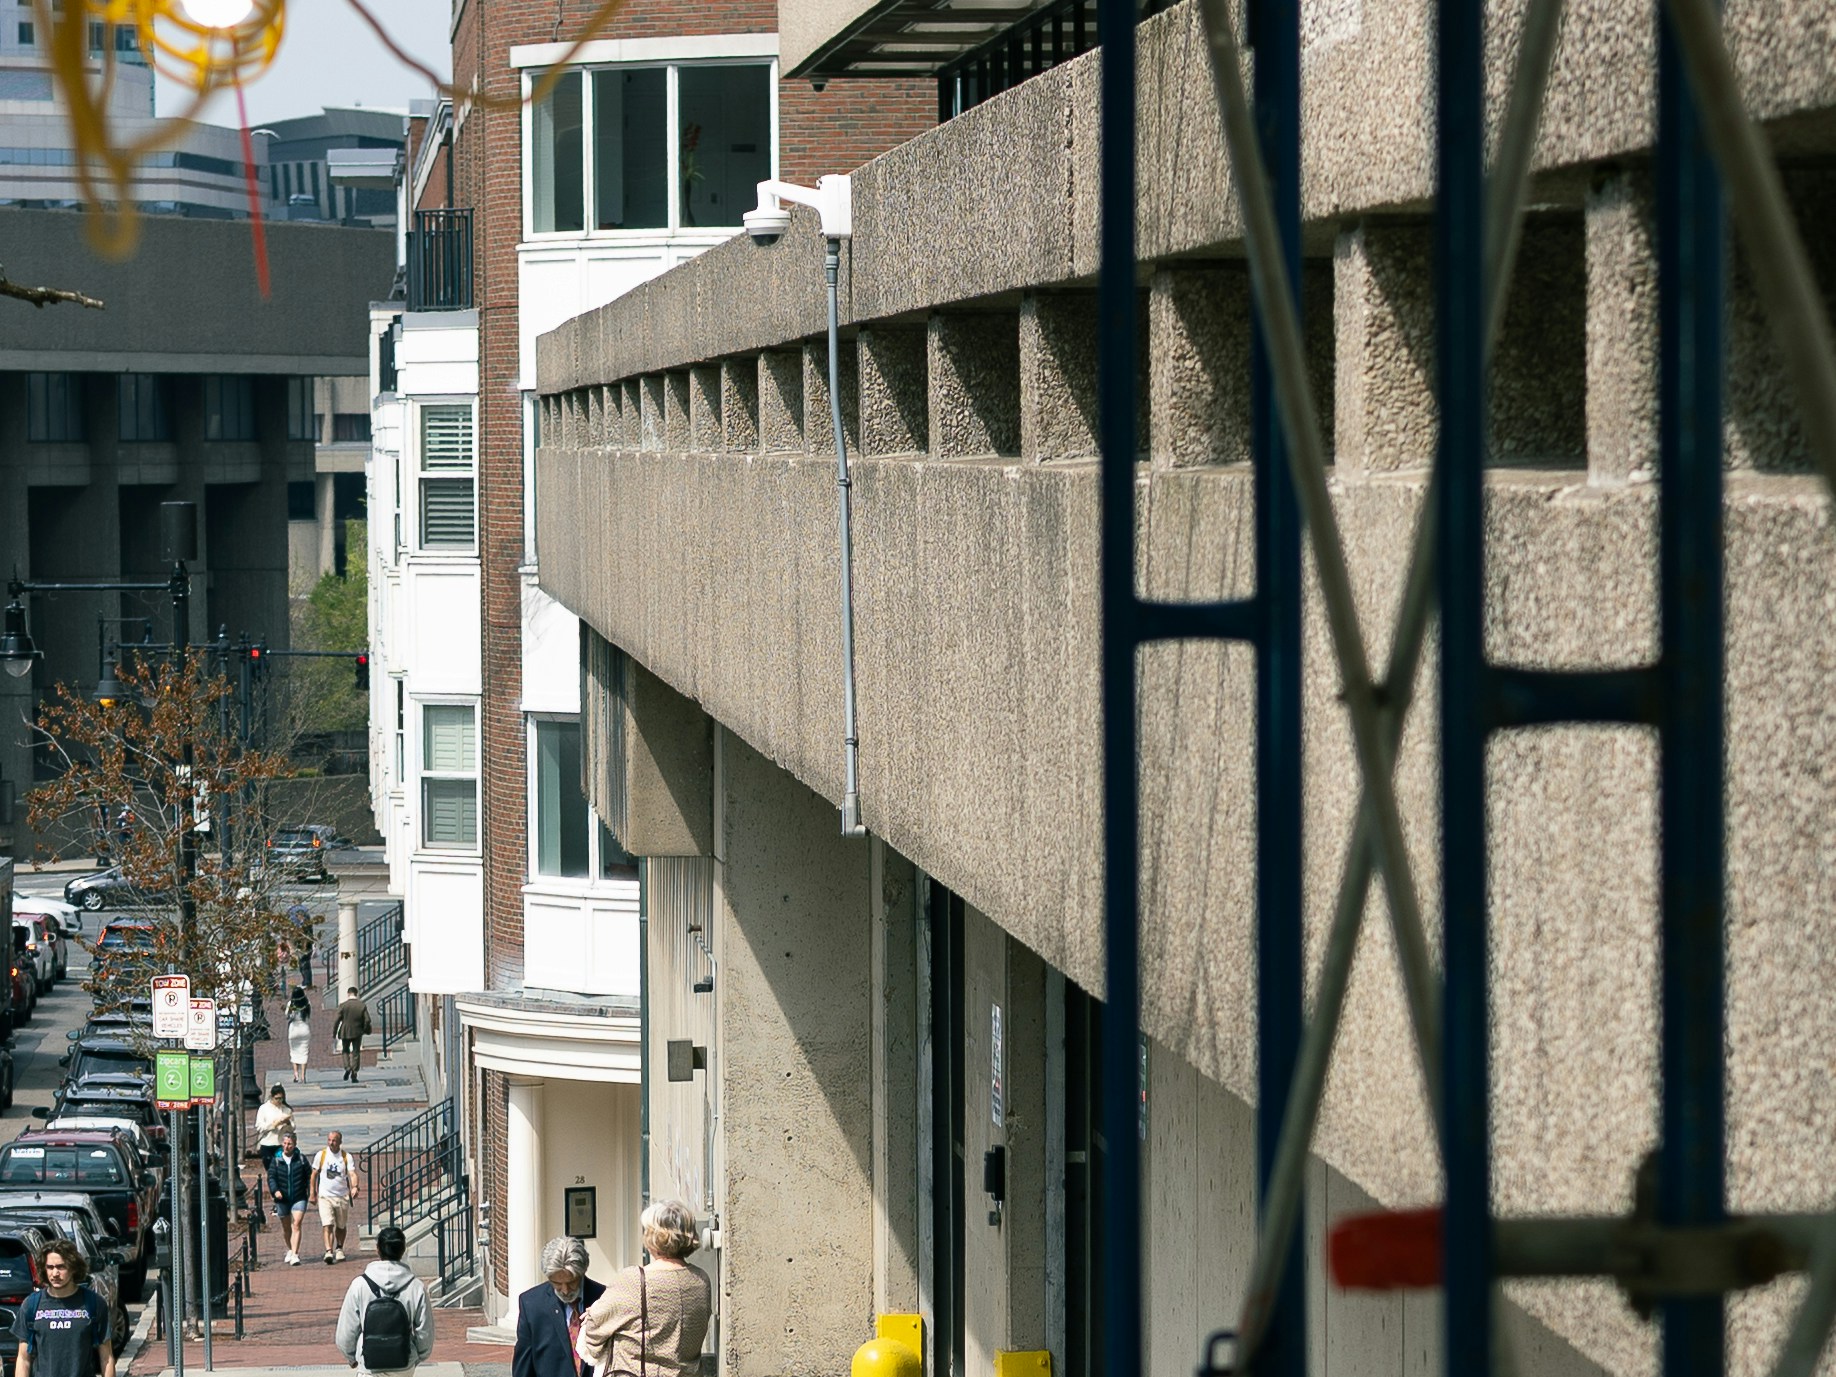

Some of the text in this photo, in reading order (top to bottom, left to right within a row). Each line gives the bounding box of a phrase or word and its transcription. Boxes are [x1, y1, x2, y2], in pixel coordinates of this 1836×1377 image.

[155, 978, 186, 988] TOW ZONE
[575, 1175, 585, 1184] 28
[49, 1320, 72, 1330] DAD
